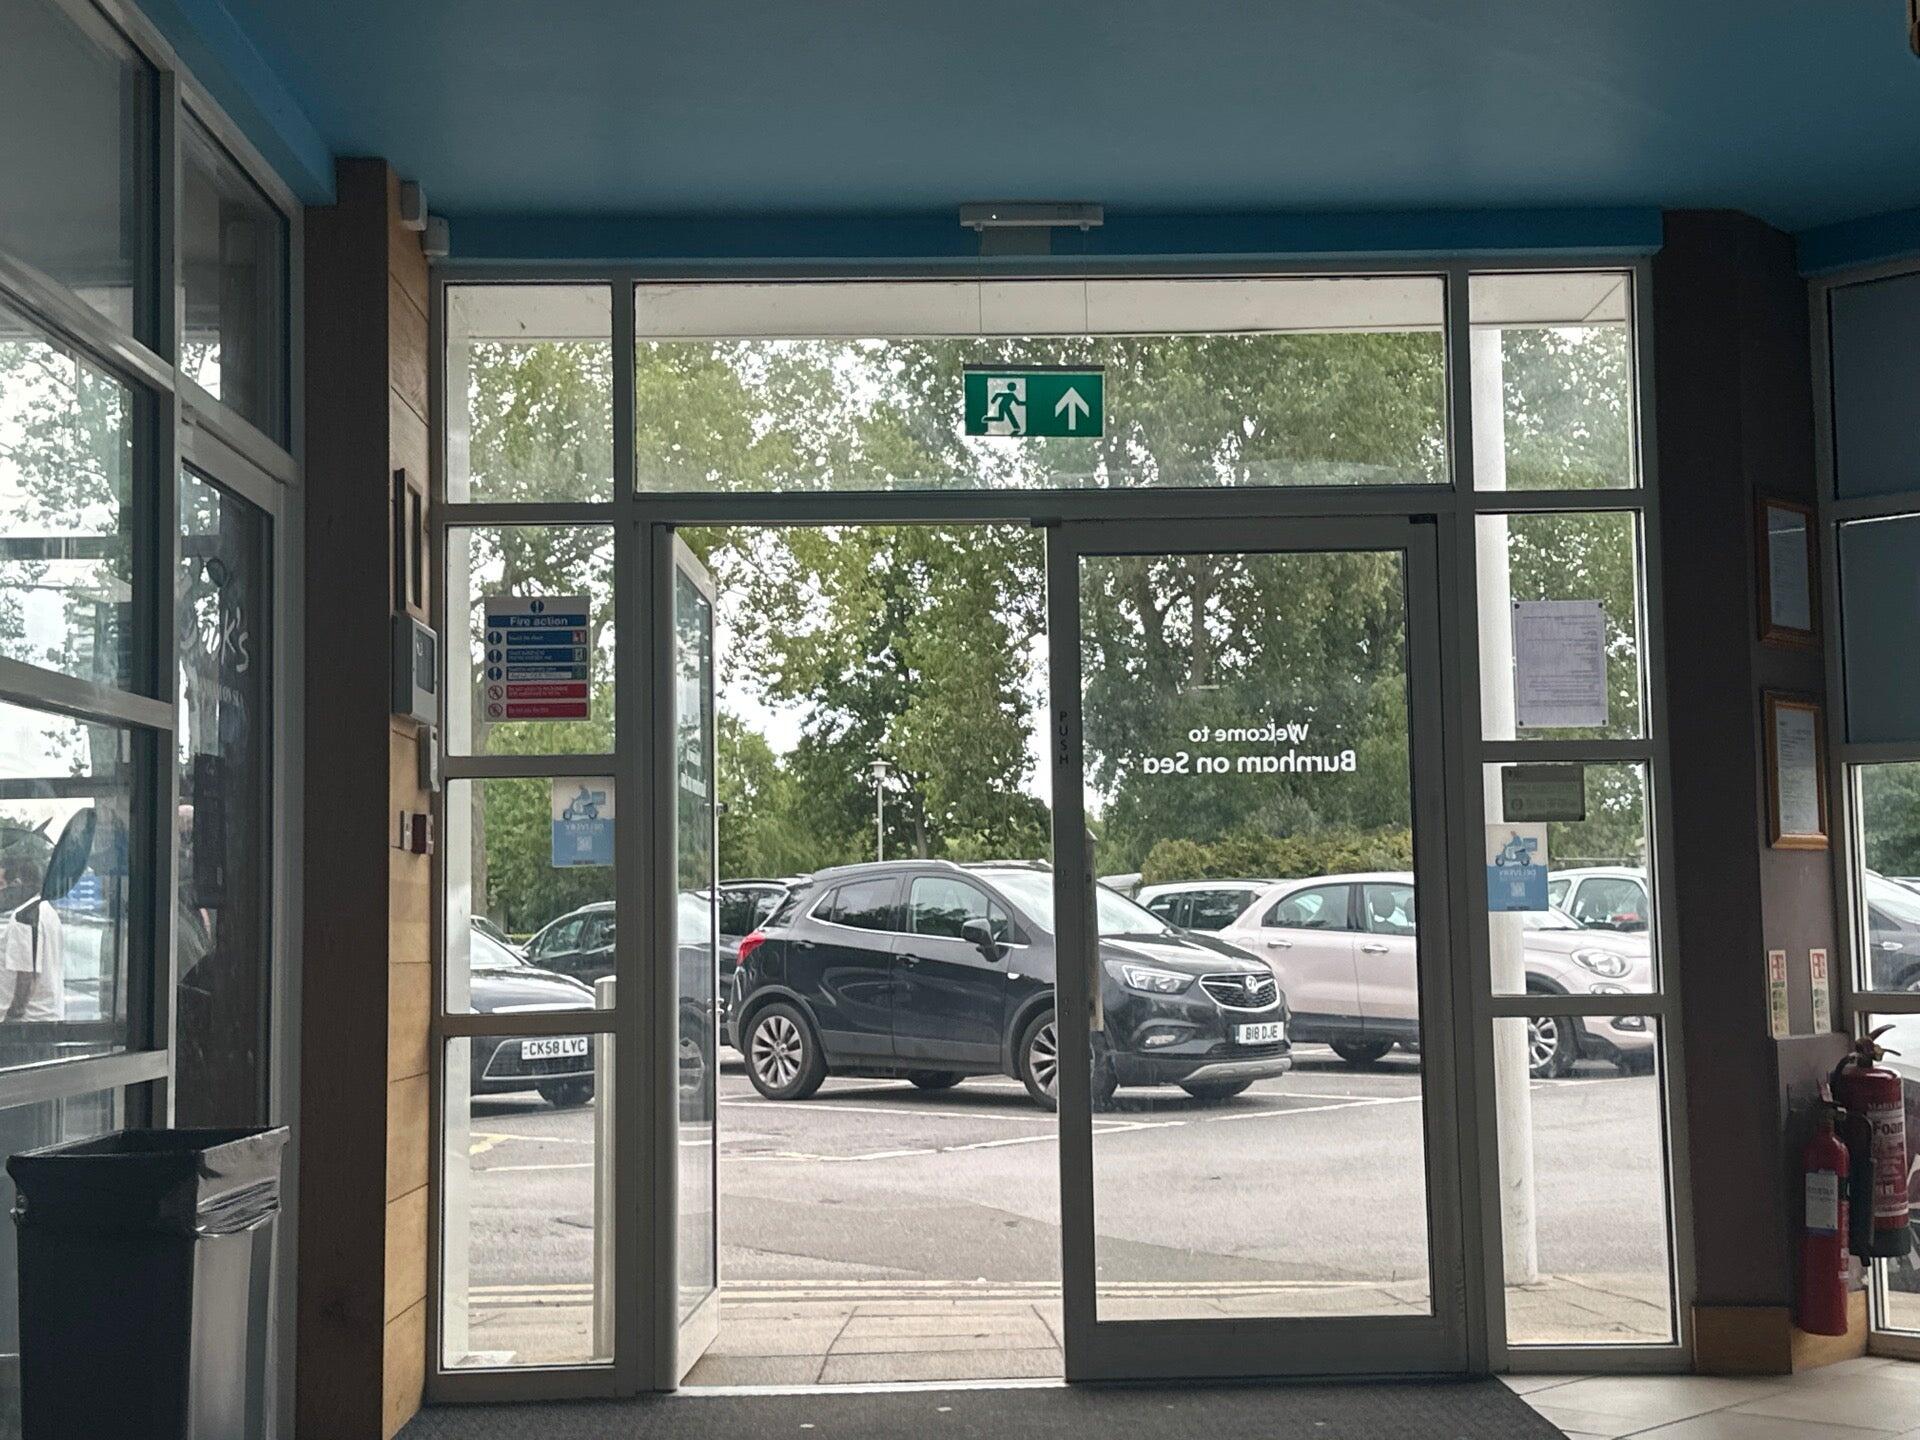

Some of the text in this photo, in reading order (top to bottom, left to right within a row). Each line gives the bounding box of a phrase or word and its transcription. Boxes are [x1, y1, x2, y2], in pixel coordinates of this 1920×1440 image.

[509, 616, 569, 627] Fire action
[1059, 710, 1069, 765] PUSH
[529, 1038, 586, 1056] CK58 LYC
